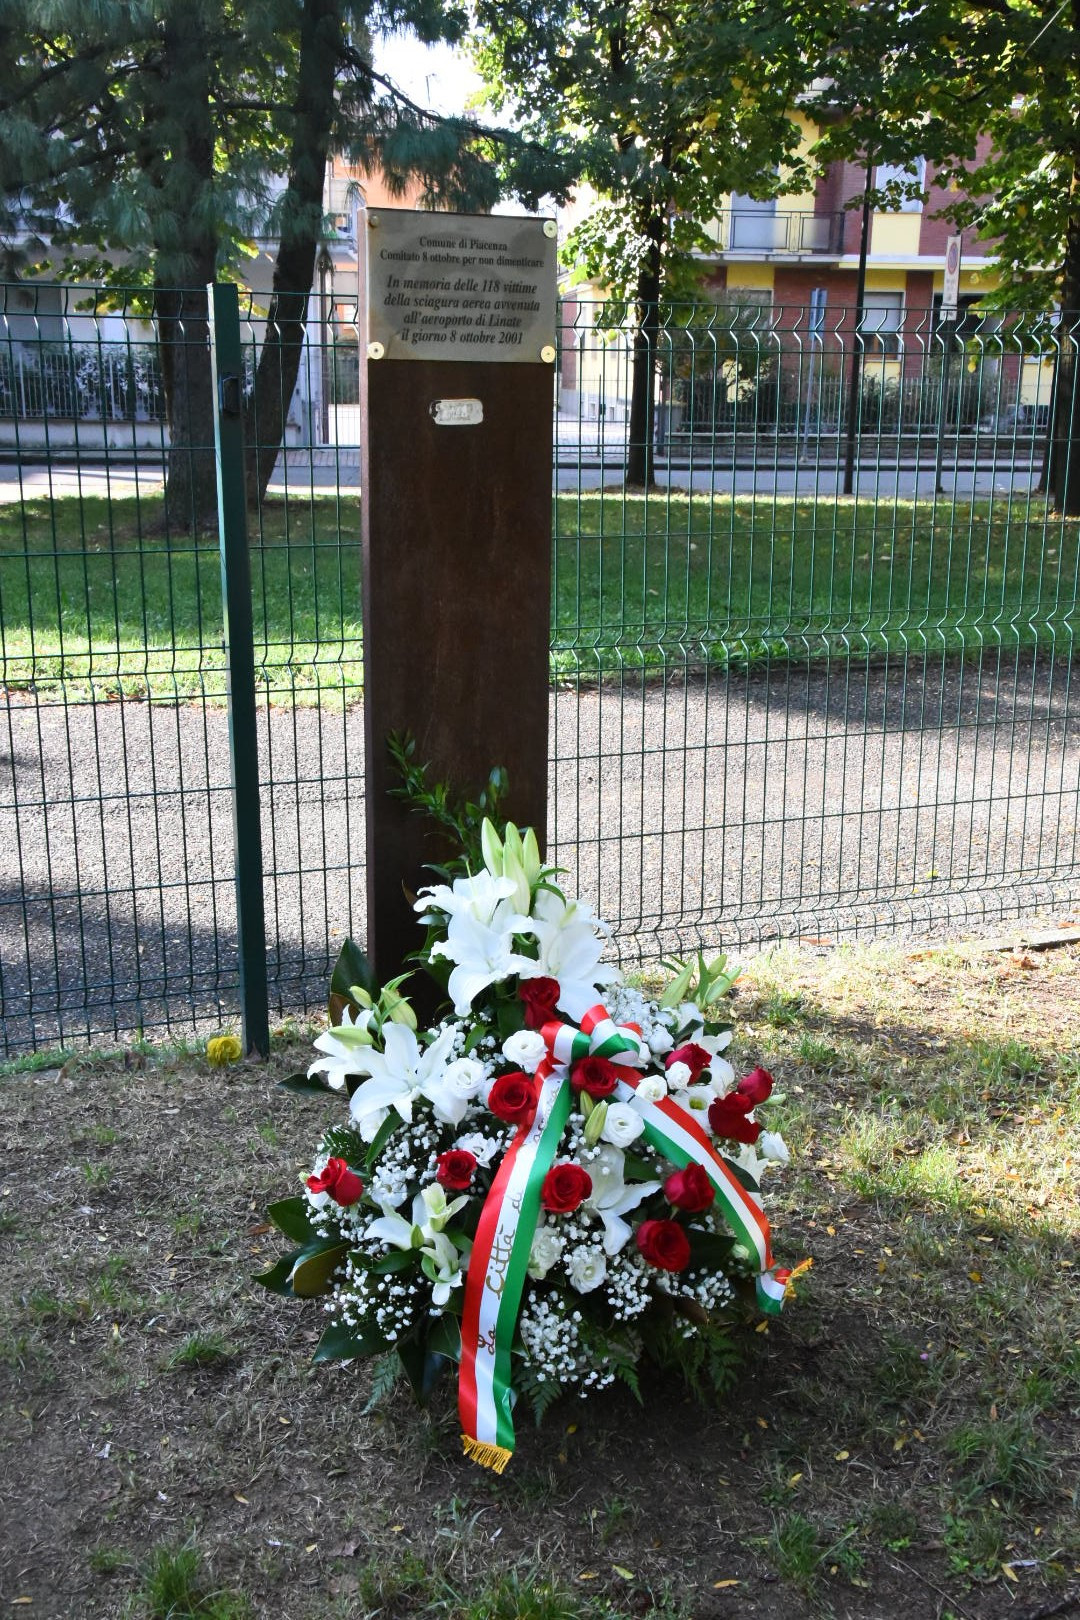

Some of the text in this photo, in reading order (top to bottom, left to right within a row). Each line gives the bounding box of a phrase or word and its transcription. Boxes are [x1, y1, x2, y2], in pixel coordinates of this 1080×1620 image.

[419, 236, 508, 251] Comune di Piacenza
[380, 249, 545, 268] Comitato 8 ottobre per non dimenticare
[387, 275, 538, 294] In memoria delle 118 vittime
[383, 293, 541, 312] della sciagura aerea avvenuta
[475, 313, 487, 327] di
[488, 314, 522, 328] Linate
[401, 328, 523, 345] il giorno 8 ottobre 2001
[486, 1224, 516, 1301] Città
[478, 1324, 497, 1356] La
